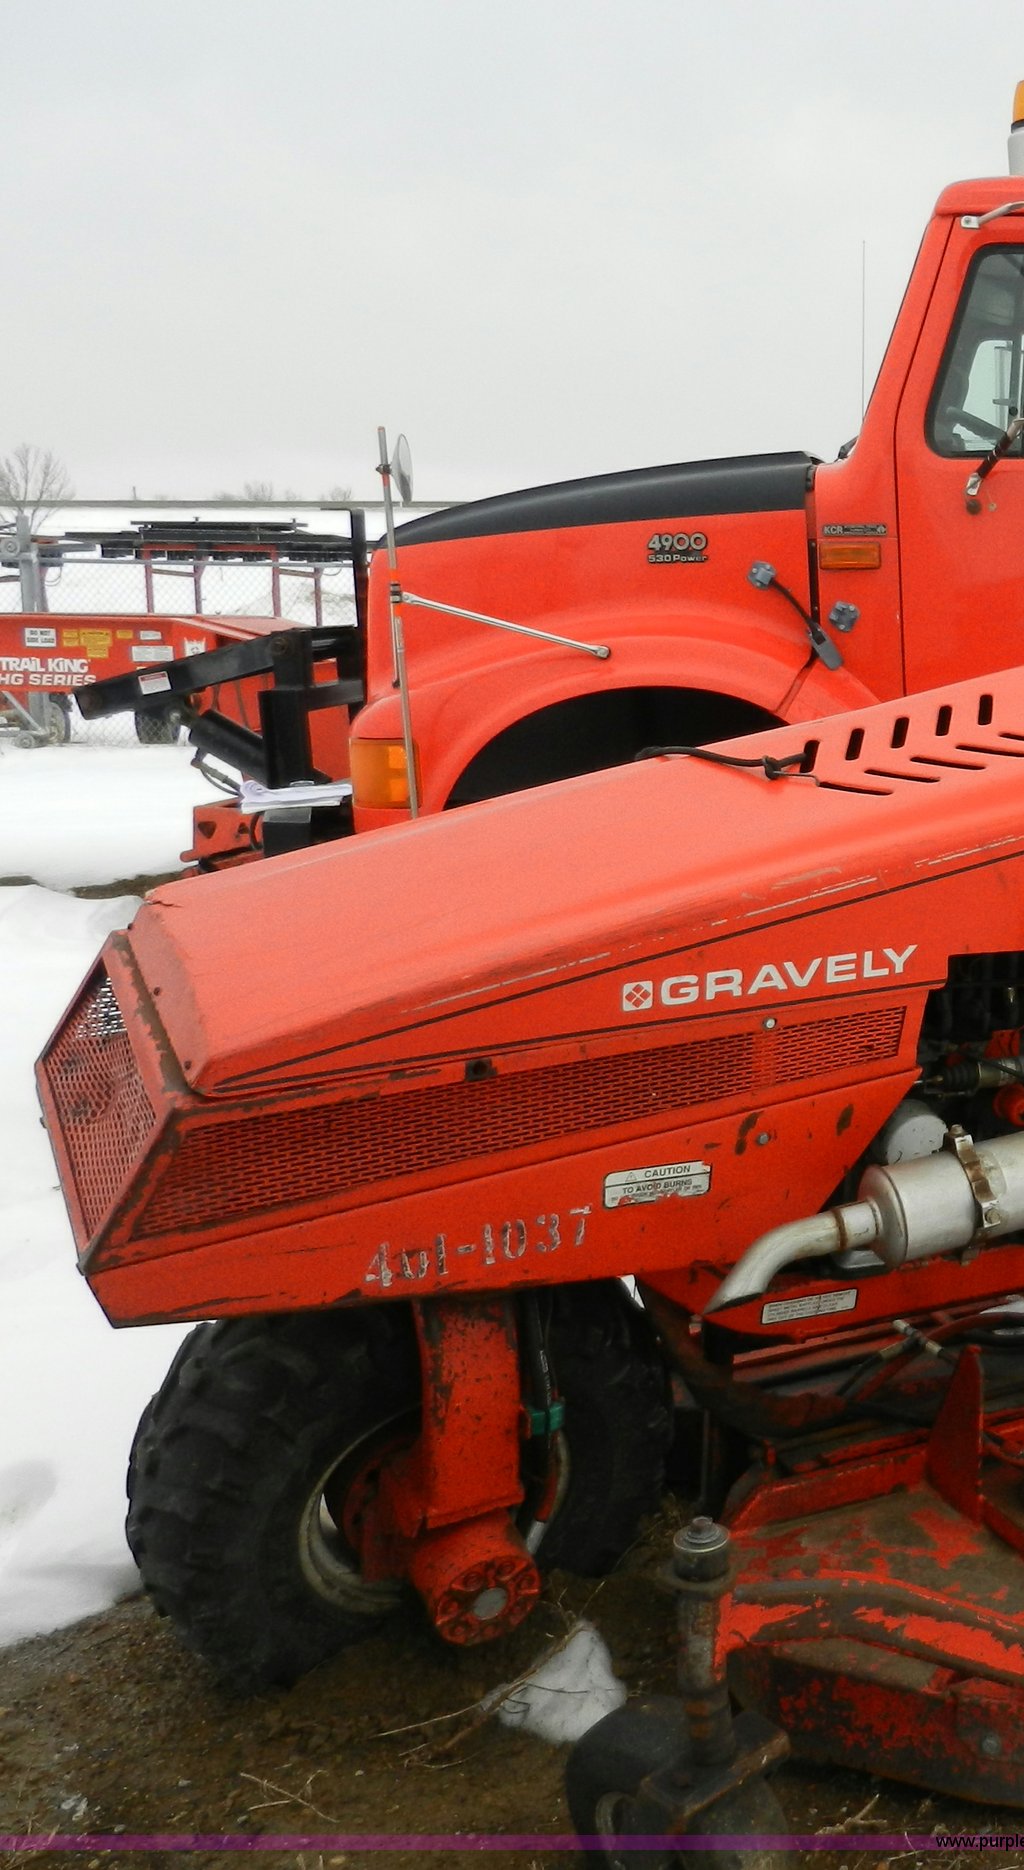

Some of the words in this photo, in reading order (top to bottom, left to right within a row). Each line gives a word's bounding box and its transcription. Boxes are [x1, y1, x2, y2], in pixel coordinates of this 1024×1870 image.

[823, 525, 844, 535] KCR
[647, 532, 708, 551] 4900
[0, 656, 45, 672] TRAIL
[47, 657, 89, 674] KING
[0, 673, 24, 686] HG
[28, 674, 97, 687] SERIES
[660, 944, 918, 1006] GRAVELY
[644, 1165, 692, 1179] CAUTION
[622, 1186, 634, 1194] TO
[635, 1182, 662, 1192] AVOID
[663, 1179, 693, 1189] BURNS
